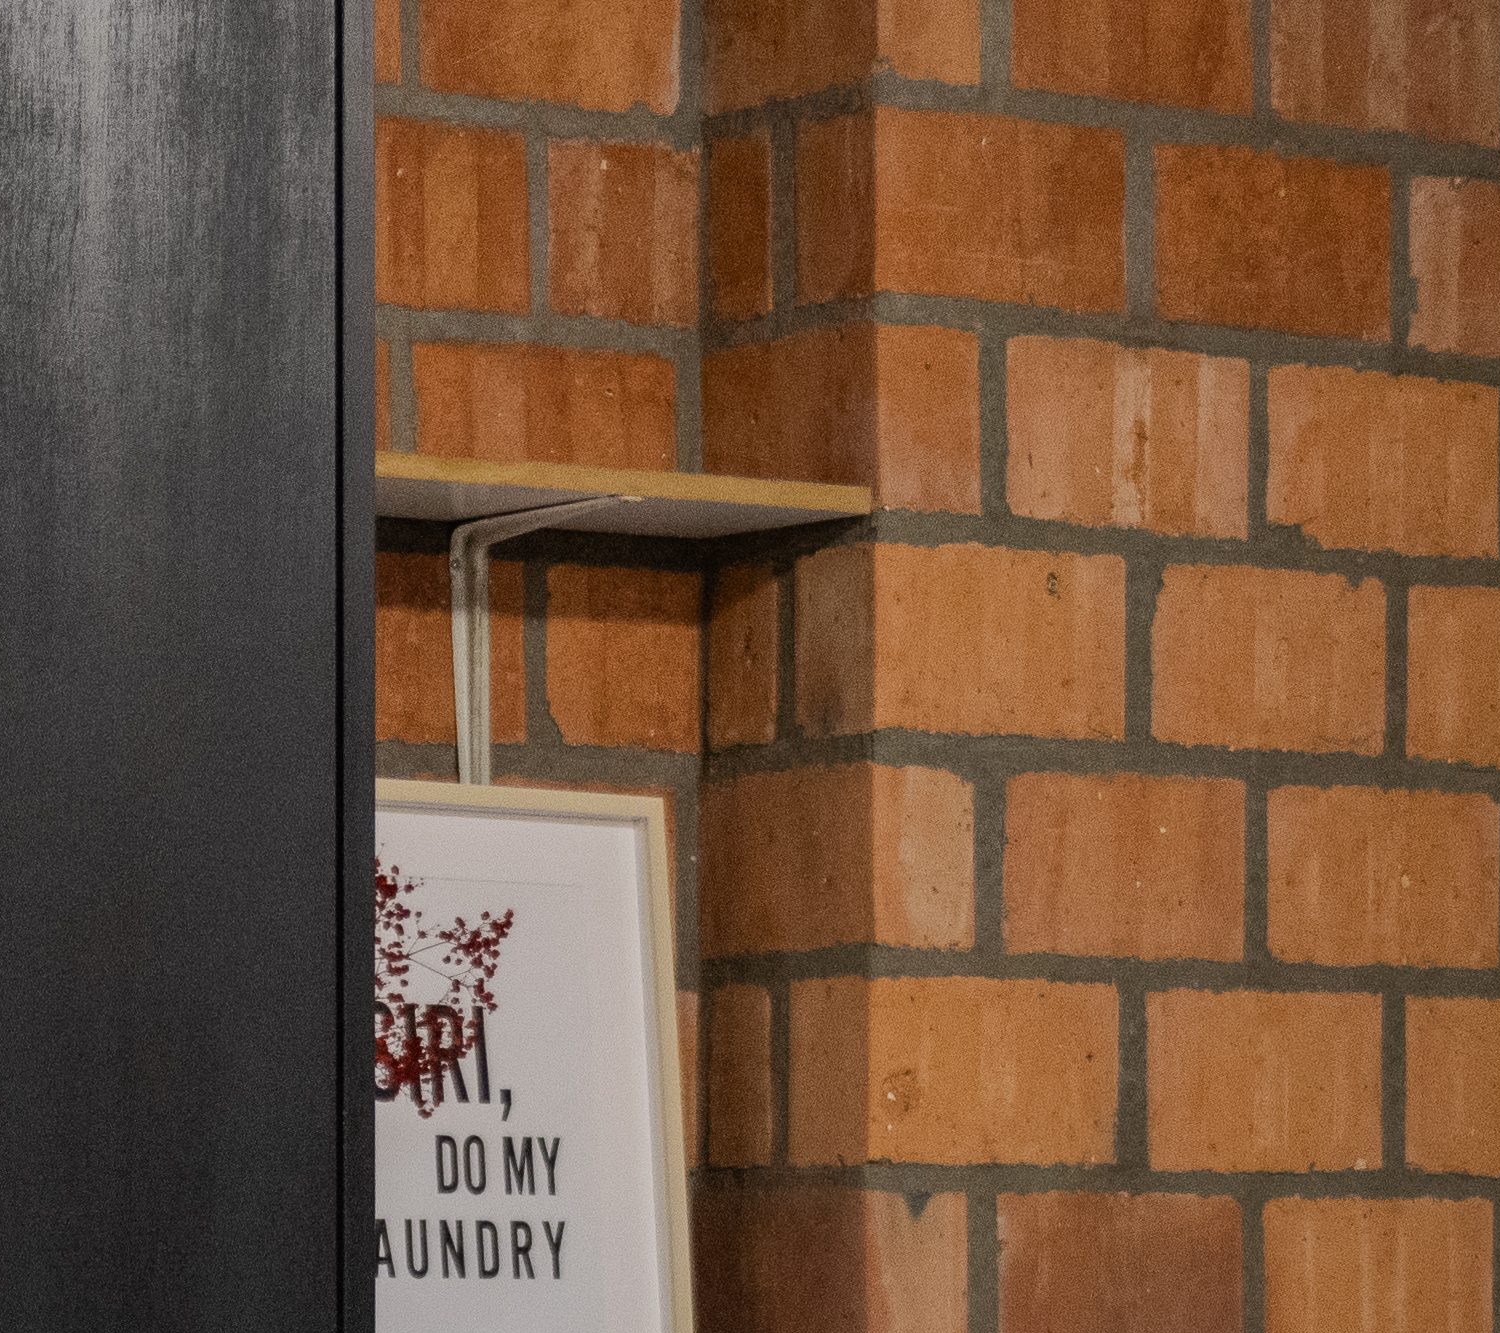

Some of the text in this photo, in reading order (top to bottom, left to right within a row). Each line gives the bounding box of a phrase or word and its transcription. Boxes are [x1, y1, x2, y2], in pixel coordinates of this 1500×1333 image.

[436, 1135, 560, 1195] DO MY
[375, 1218, 565, 1280] AUNDRY
